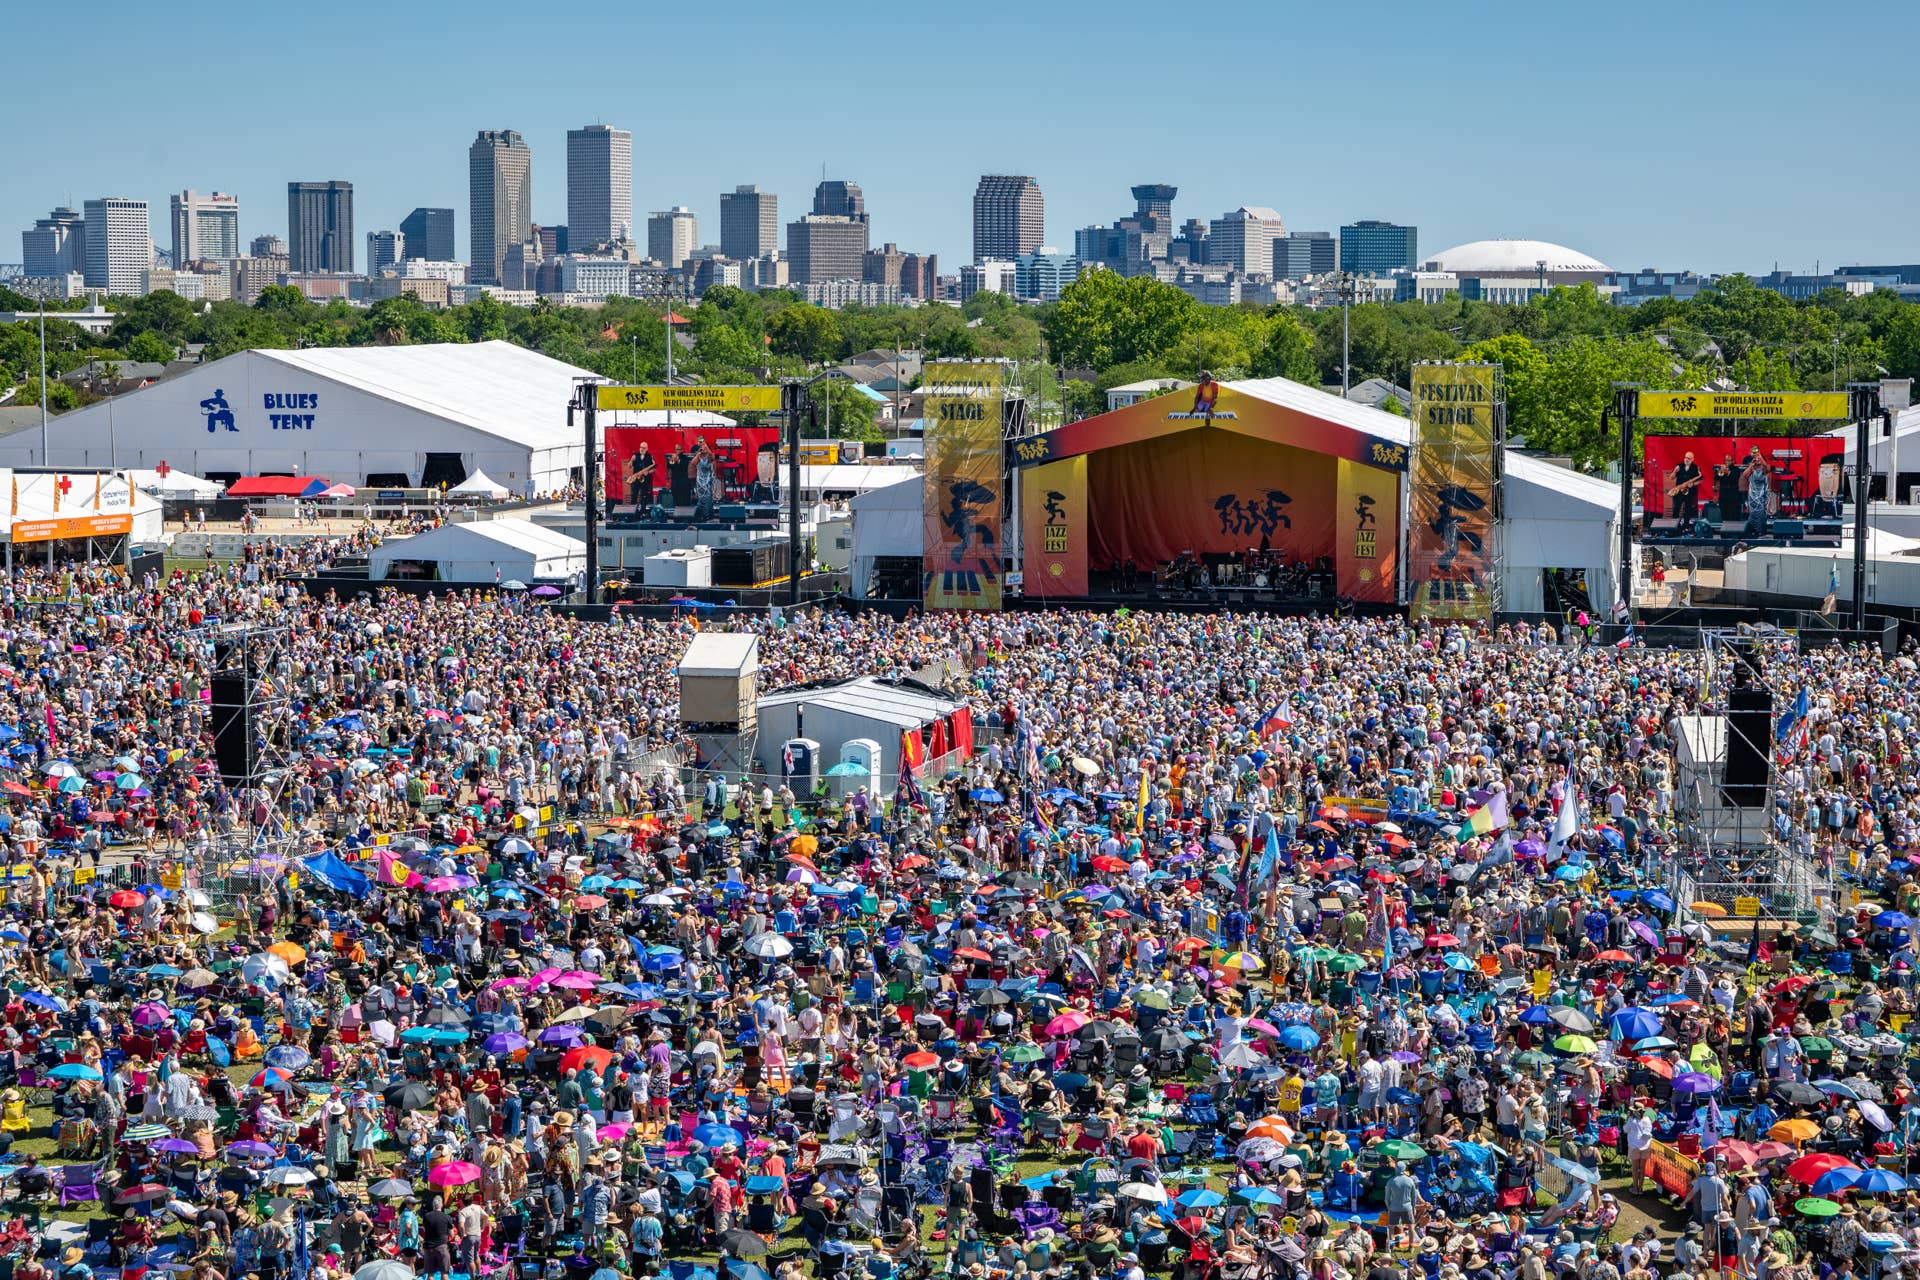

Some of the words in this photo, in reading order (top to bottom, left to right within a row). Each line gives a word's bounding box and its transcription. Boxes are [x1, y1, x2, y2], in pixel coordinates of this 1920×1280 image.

[705, 390, 719, 398] JAZZ
[1420, 384, 1486, 402] FESTIVAL
[264, 393, 318, 409] BLUES
[1714, 396, 1728, 404] NEW
[1729, 396, 1760, 404] ORLEANS
[1761, 396, 1777, 405] JAZZ
[941, 403, 985, 420] STAGE
[1429, 407, 1475, 425] STAGE
[1714, 406, 1749, 415] HERITAGE
[1751, 406, 1784, 415] FESTIVAL
[269, 414, 315, 430] TENT
[1045, 526, 1067, 538] JAZZ
[1356, 531, 1376, 543] JAZZ
[1045, 540, 1067, 551] FEST
[1355, 545, 1376, 556] FEST
[1284, 1090, 1298, 1100] 33
